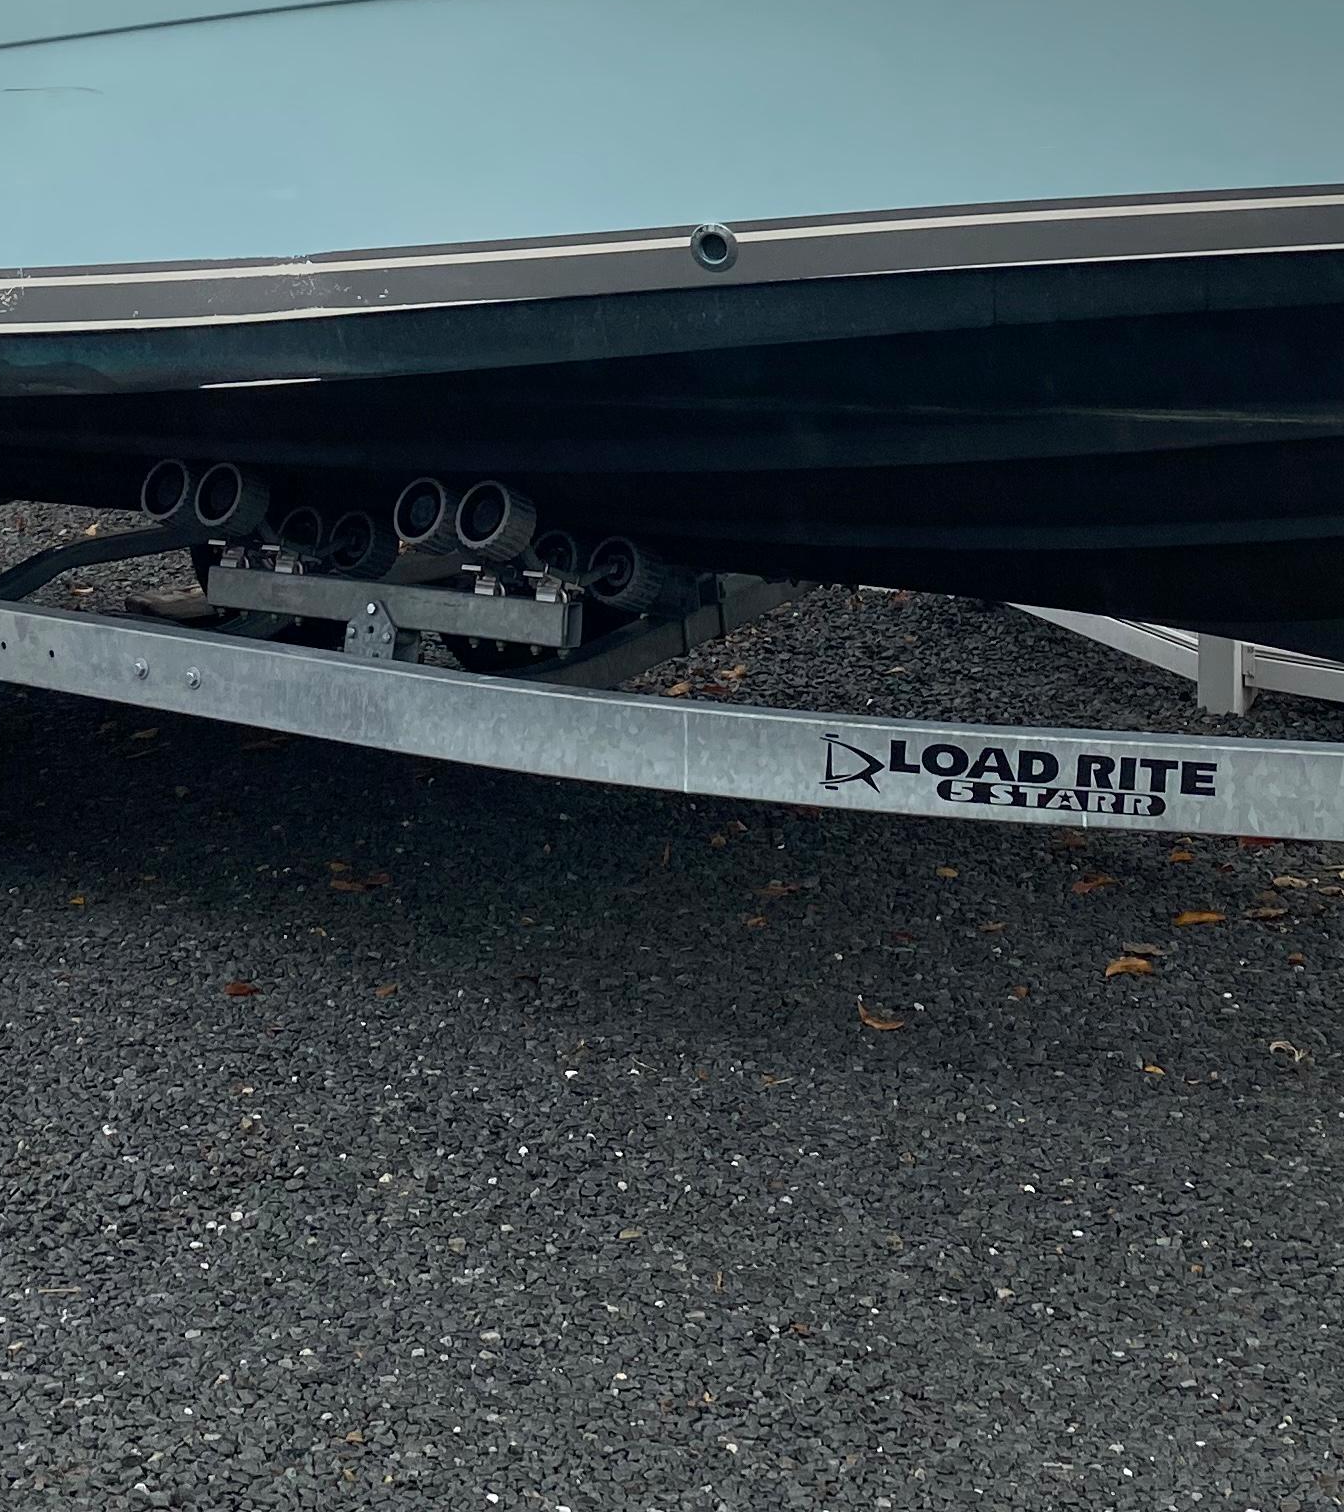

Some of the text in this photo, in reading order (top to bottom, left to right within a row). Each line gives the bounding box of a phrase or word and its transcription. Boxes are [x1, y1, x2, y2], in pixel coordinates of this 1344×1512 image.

[889, 739, 1218, 797] LOAD RITE
[950, 781, 1153, 816] 5 STARR
